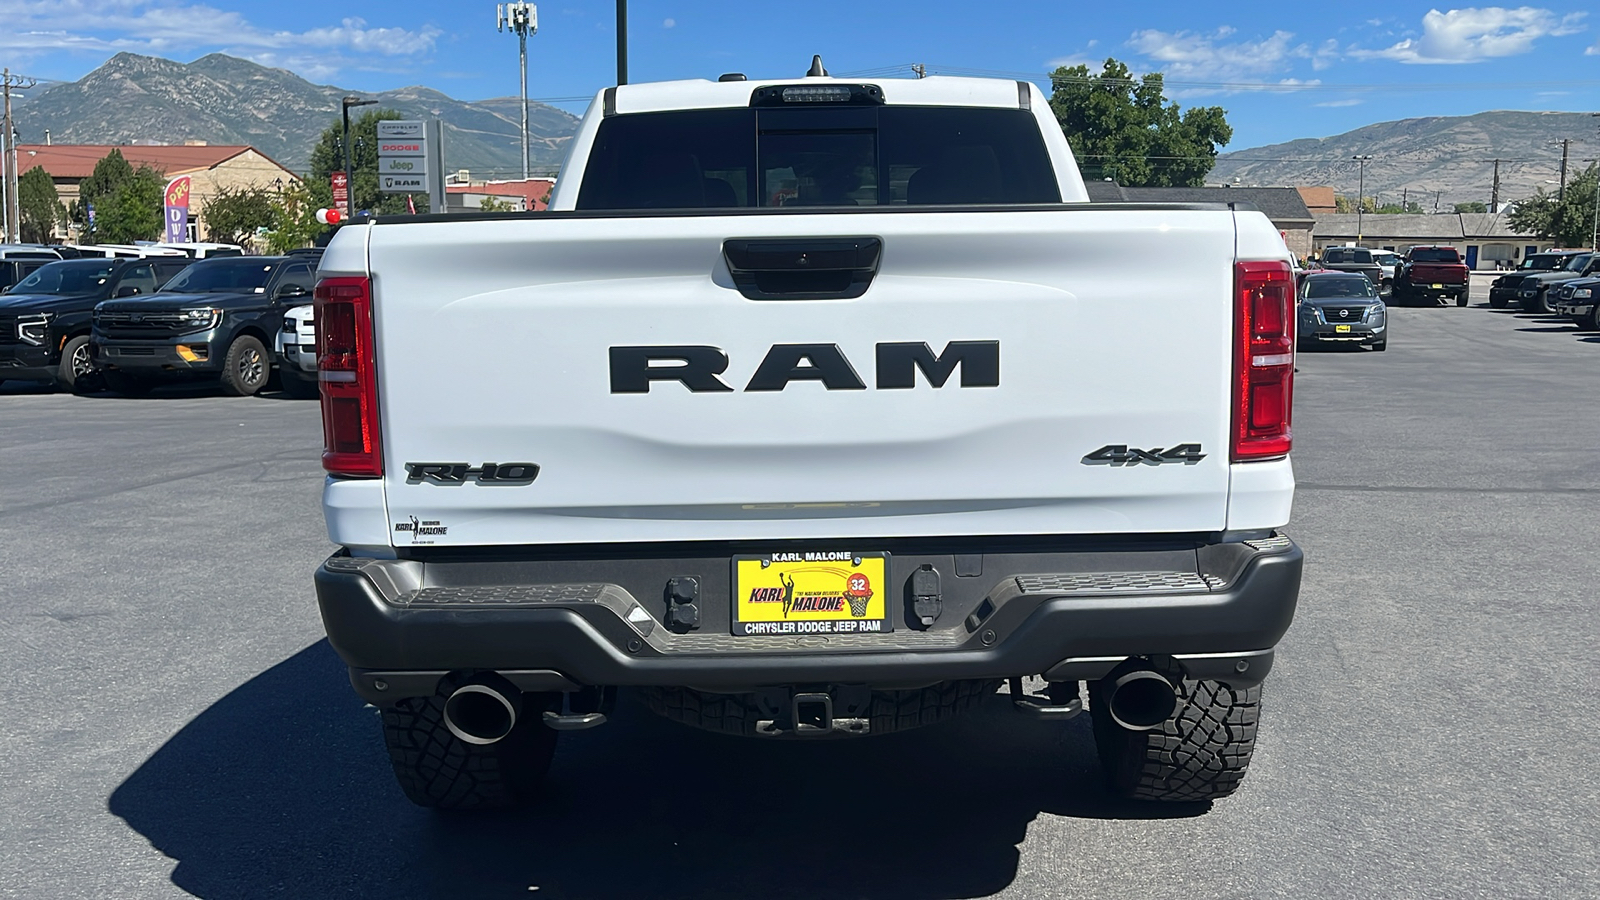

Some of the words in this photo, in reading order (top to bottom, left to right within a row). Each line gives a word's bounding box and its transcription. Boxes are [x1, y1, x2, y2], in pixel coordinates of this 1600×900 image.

[390, 160, 413, 170] Jeep
[169, 180, 188, 205] PRE
[609, 340, 1000, 394] RAM
[404, 461, 541, 487] RHO
[395, 523, 413, 531] KARL
[419, 527, 447, 535] MALONE
[772, 553, 802, 562] KARL
[805, 552, 852, 561] MALONE
[851, 579, 865, 591] 32
[749, 588, 784, 603] KARL
[791, 597, 844, 611] MALONE
[745, 622, 796, 634] CHRYSLER
[797, 621, 832, 633] DODGE
[833, 621, 857, 632] JEEP
[859, 620, 881, 631] RAM
